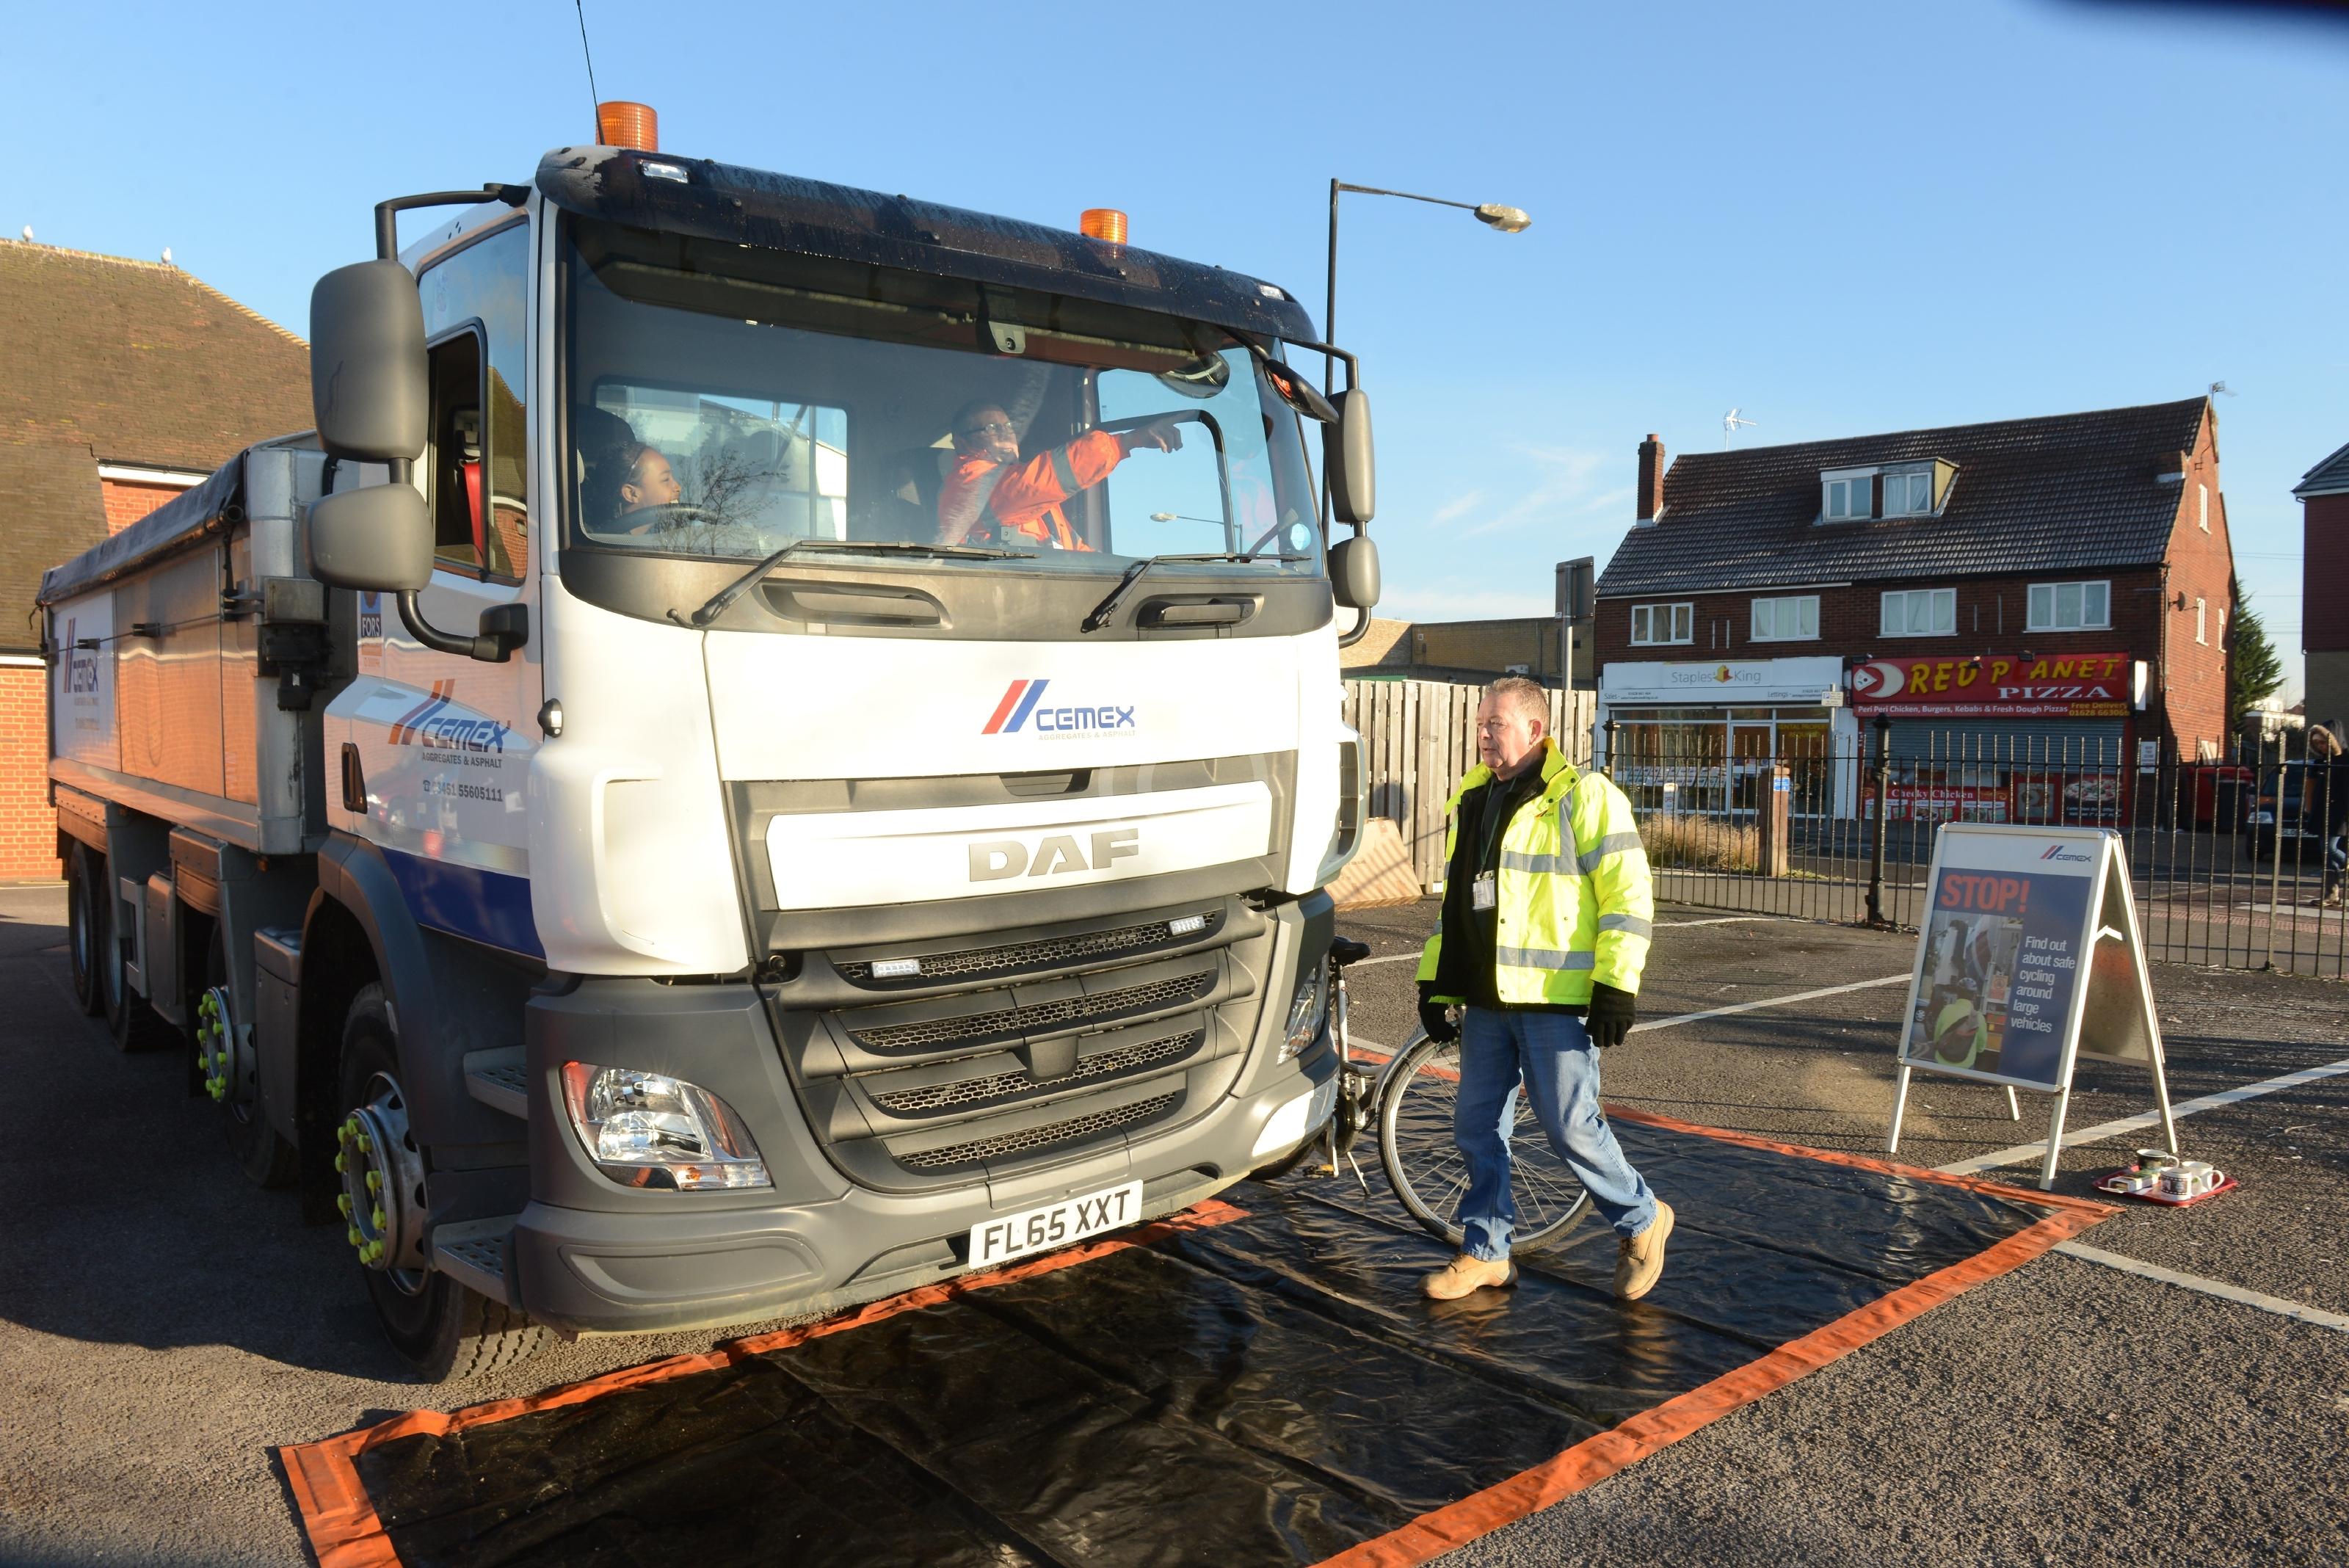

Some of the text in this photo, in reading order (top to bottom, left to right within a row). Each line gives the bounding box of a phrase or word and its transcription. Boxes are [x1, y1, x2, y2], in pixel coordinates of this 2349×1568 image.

[362, 617, 381, 636] FORS
[1734, 669, 1761, 683] King
[1909, 661, 1978, 694] RED
[1997, 686, 2113, 698] PIZZA
[1889, 705, 1920, 714] Chicken,
[1922, 705, 1953, 714] Burgers,
[2016, 705, 2042, 714] Dough
[2093, 702, 2127, 710] Delivery
[1036, 705, 1136, 731] CEMEX
[421, 717, 511, 754] CEMEX
[1038, 732, 1092, 741] AGGREGATES
[1103, 730, 1136, 738] ASPHALT
[422, 752, 502, 768] AGGREGATES & ASPHALT
[458, 784, 503, 802] 55605111
[1932, 788, 1974, 799] Chicken
[968, 828, 1139, 882] DAF
[2055, 854, 2091, 863] CEMEX
[1940, 874, 2031, 913] STOP!
[2025, 936, 2067, 951] Find out
[2022, 953, 2076, 969] about safe
[2019, 969, 2055, 986] cycling
[2016, 986, 2052, 999] around
[2013, 999, 2039, 1015] large
[2011, 1017, 2052, 1033] vehicles
[984, 1189, 1130, 1260] FL65 XXT
